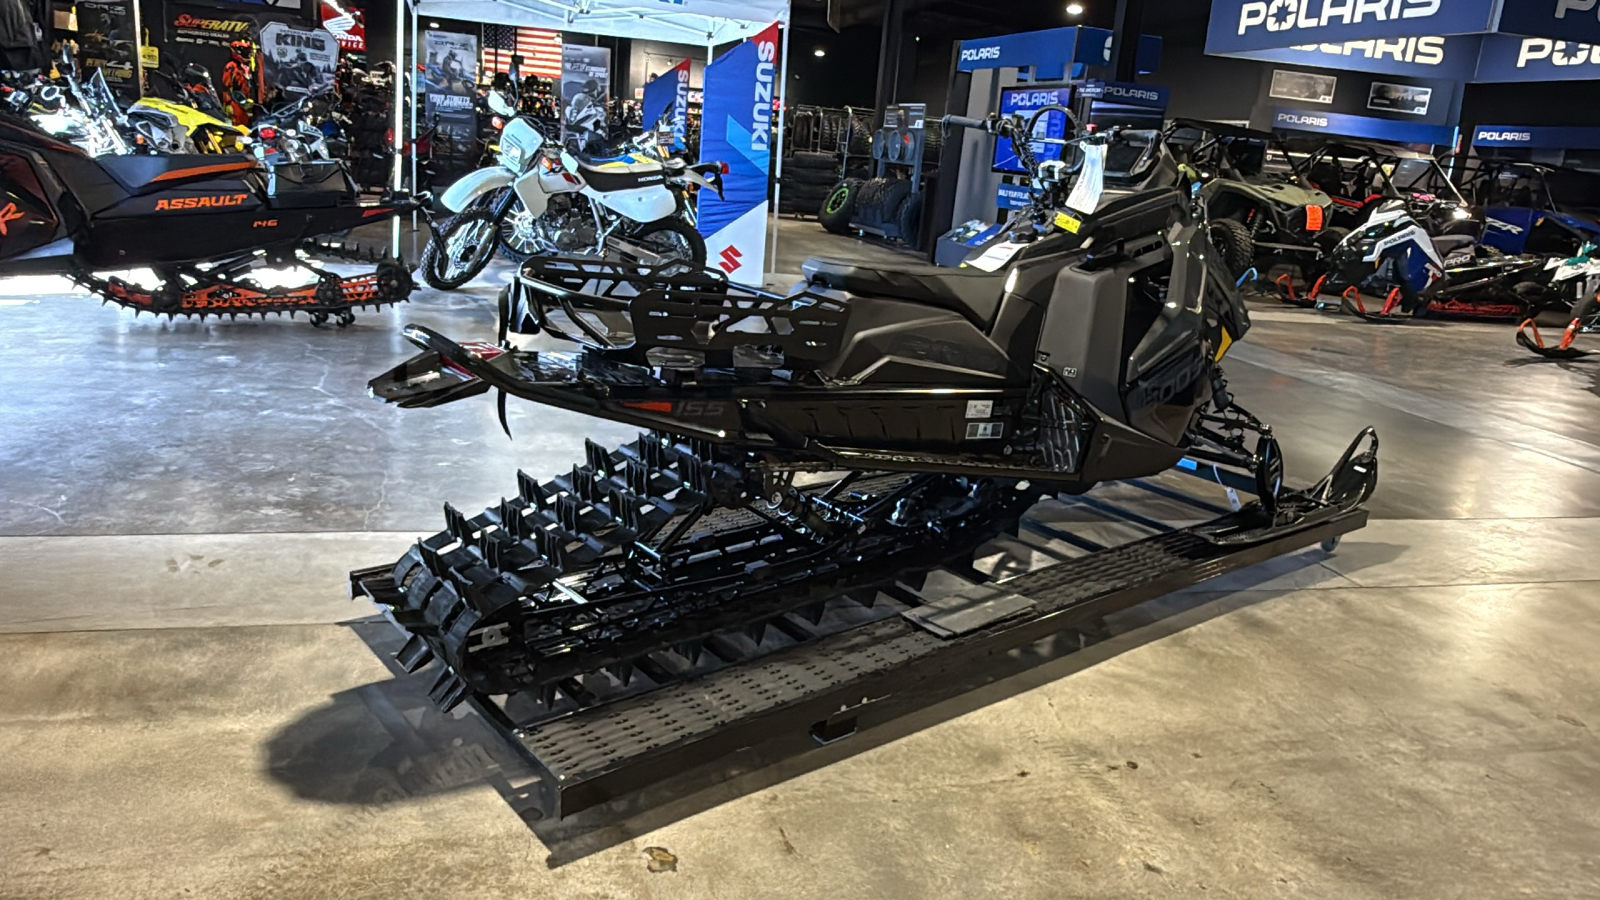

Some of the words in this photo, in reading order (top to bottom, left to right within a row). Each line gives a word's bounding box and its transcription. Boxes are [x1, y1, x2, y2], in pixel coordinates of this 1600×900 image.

[1238, 0, 1442, 35] POLARIS
[276, 32, 326, 52] KING
[332, 33, 364, 42] ONDA
[961, 46, 1000, 61] POLARIS
[751, 40, 775, 151] SUZUKI
[1010, 91, 1059, 106] POLARIS
[1104, 86, 1159, 101] POLARIS
[674, 69, 689, 138] SUZUKI
[1278, 113, 1328, 127] POLARIS
[1478, 131, 1531, 141] POLARIS
[638, 174, 664, 183] HONDA
[155, 194, 249, 211] ASSAULT
[1444, 254, 1471, 267] PRO
[676, 400, 729, 416] 155
